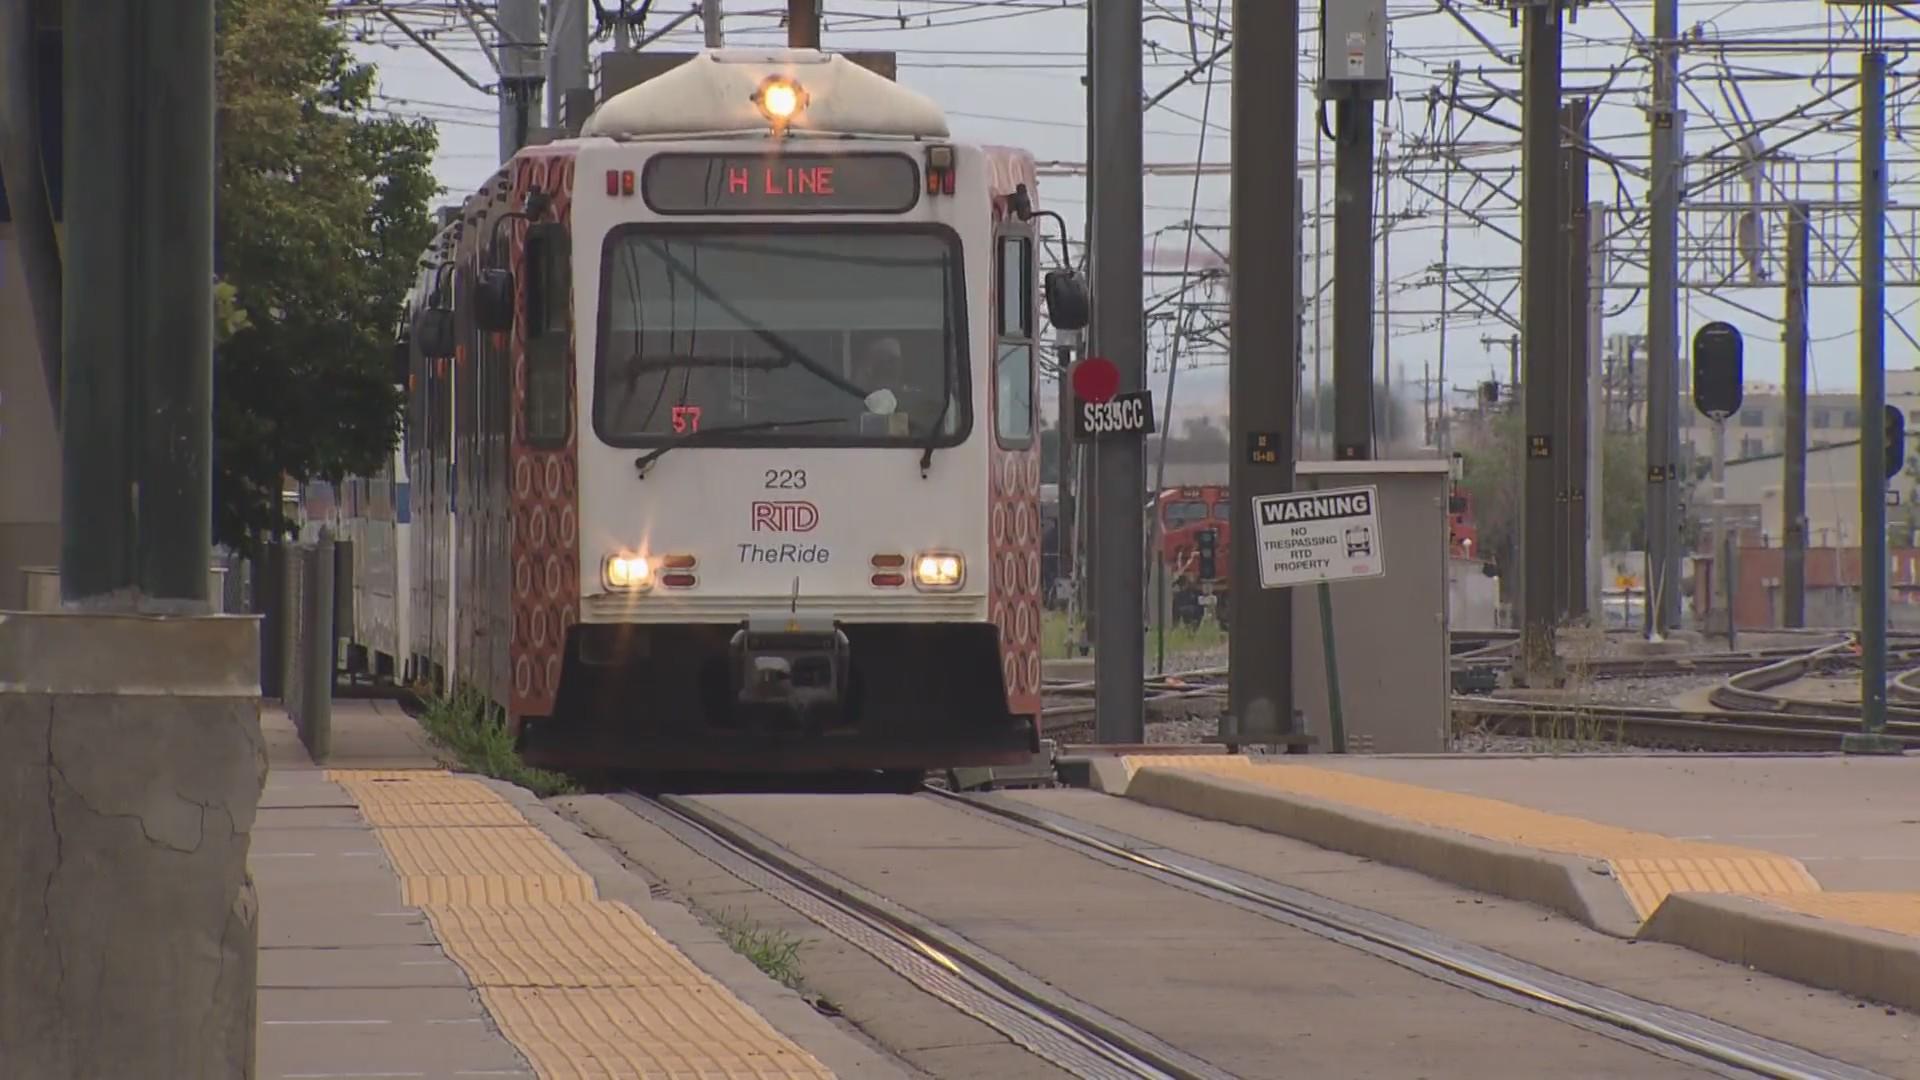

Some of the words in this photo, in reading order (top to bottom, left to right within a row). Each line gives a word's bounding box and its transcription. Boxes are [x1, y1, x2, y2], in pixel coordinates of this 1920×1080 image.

[729, 167, 748, 193] H
[766, 167, 834, 194] LINE
[672, 407, 700, 432] 57
[765, 469, 807, 489] 223
[752, 501, 819, 531] RTD
[1264, 496, 1368, 521] WARNING
[1291, 527, 1307, 537] NO
[1264, 535, 1338, 551] TRESPASSING
[738, 544, 830, 563] TheRide
[1291, 549, 1312, 559] RTD
[1274, 559, 1330, 572] PROPERTY
